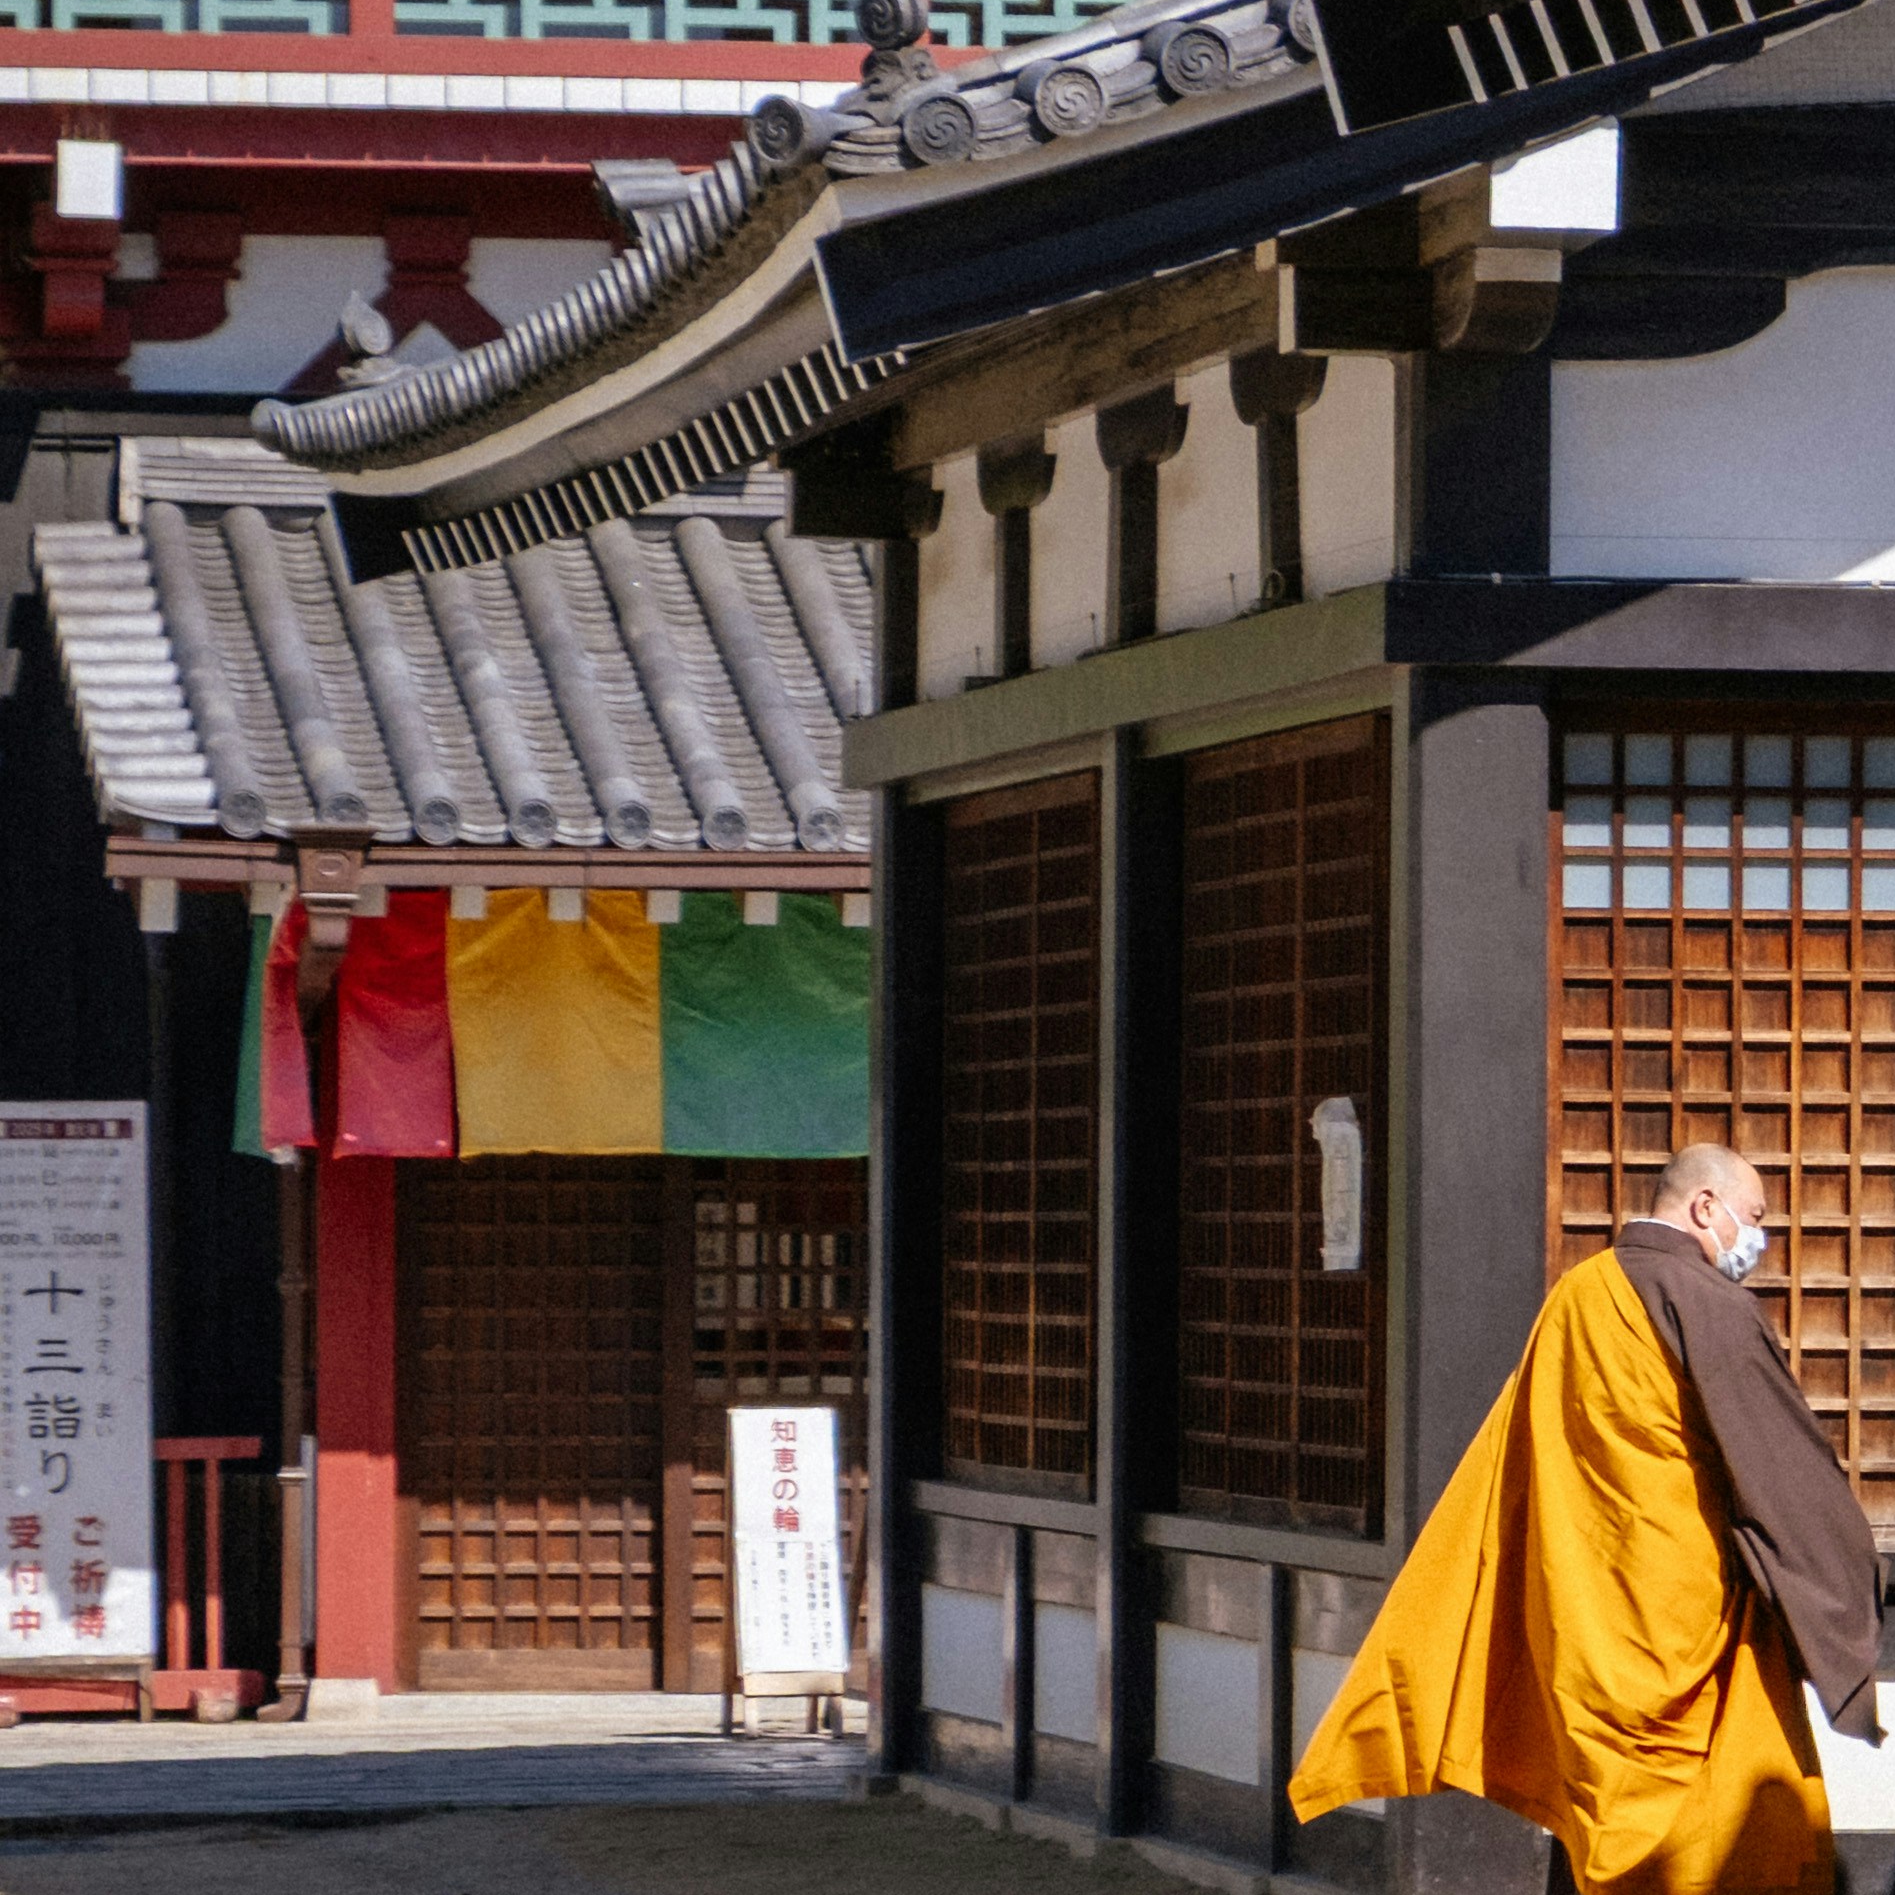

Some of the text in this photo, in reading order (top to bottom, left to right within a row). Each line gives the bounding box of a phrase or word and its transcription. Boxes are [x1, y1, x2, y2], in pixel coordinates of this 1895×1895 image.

[23, 1270, 84, 1494] 十三詣り
[771, 1418, 800, 1533] 知恵の輪
[6, 1514, 42, 1640] 受付中
